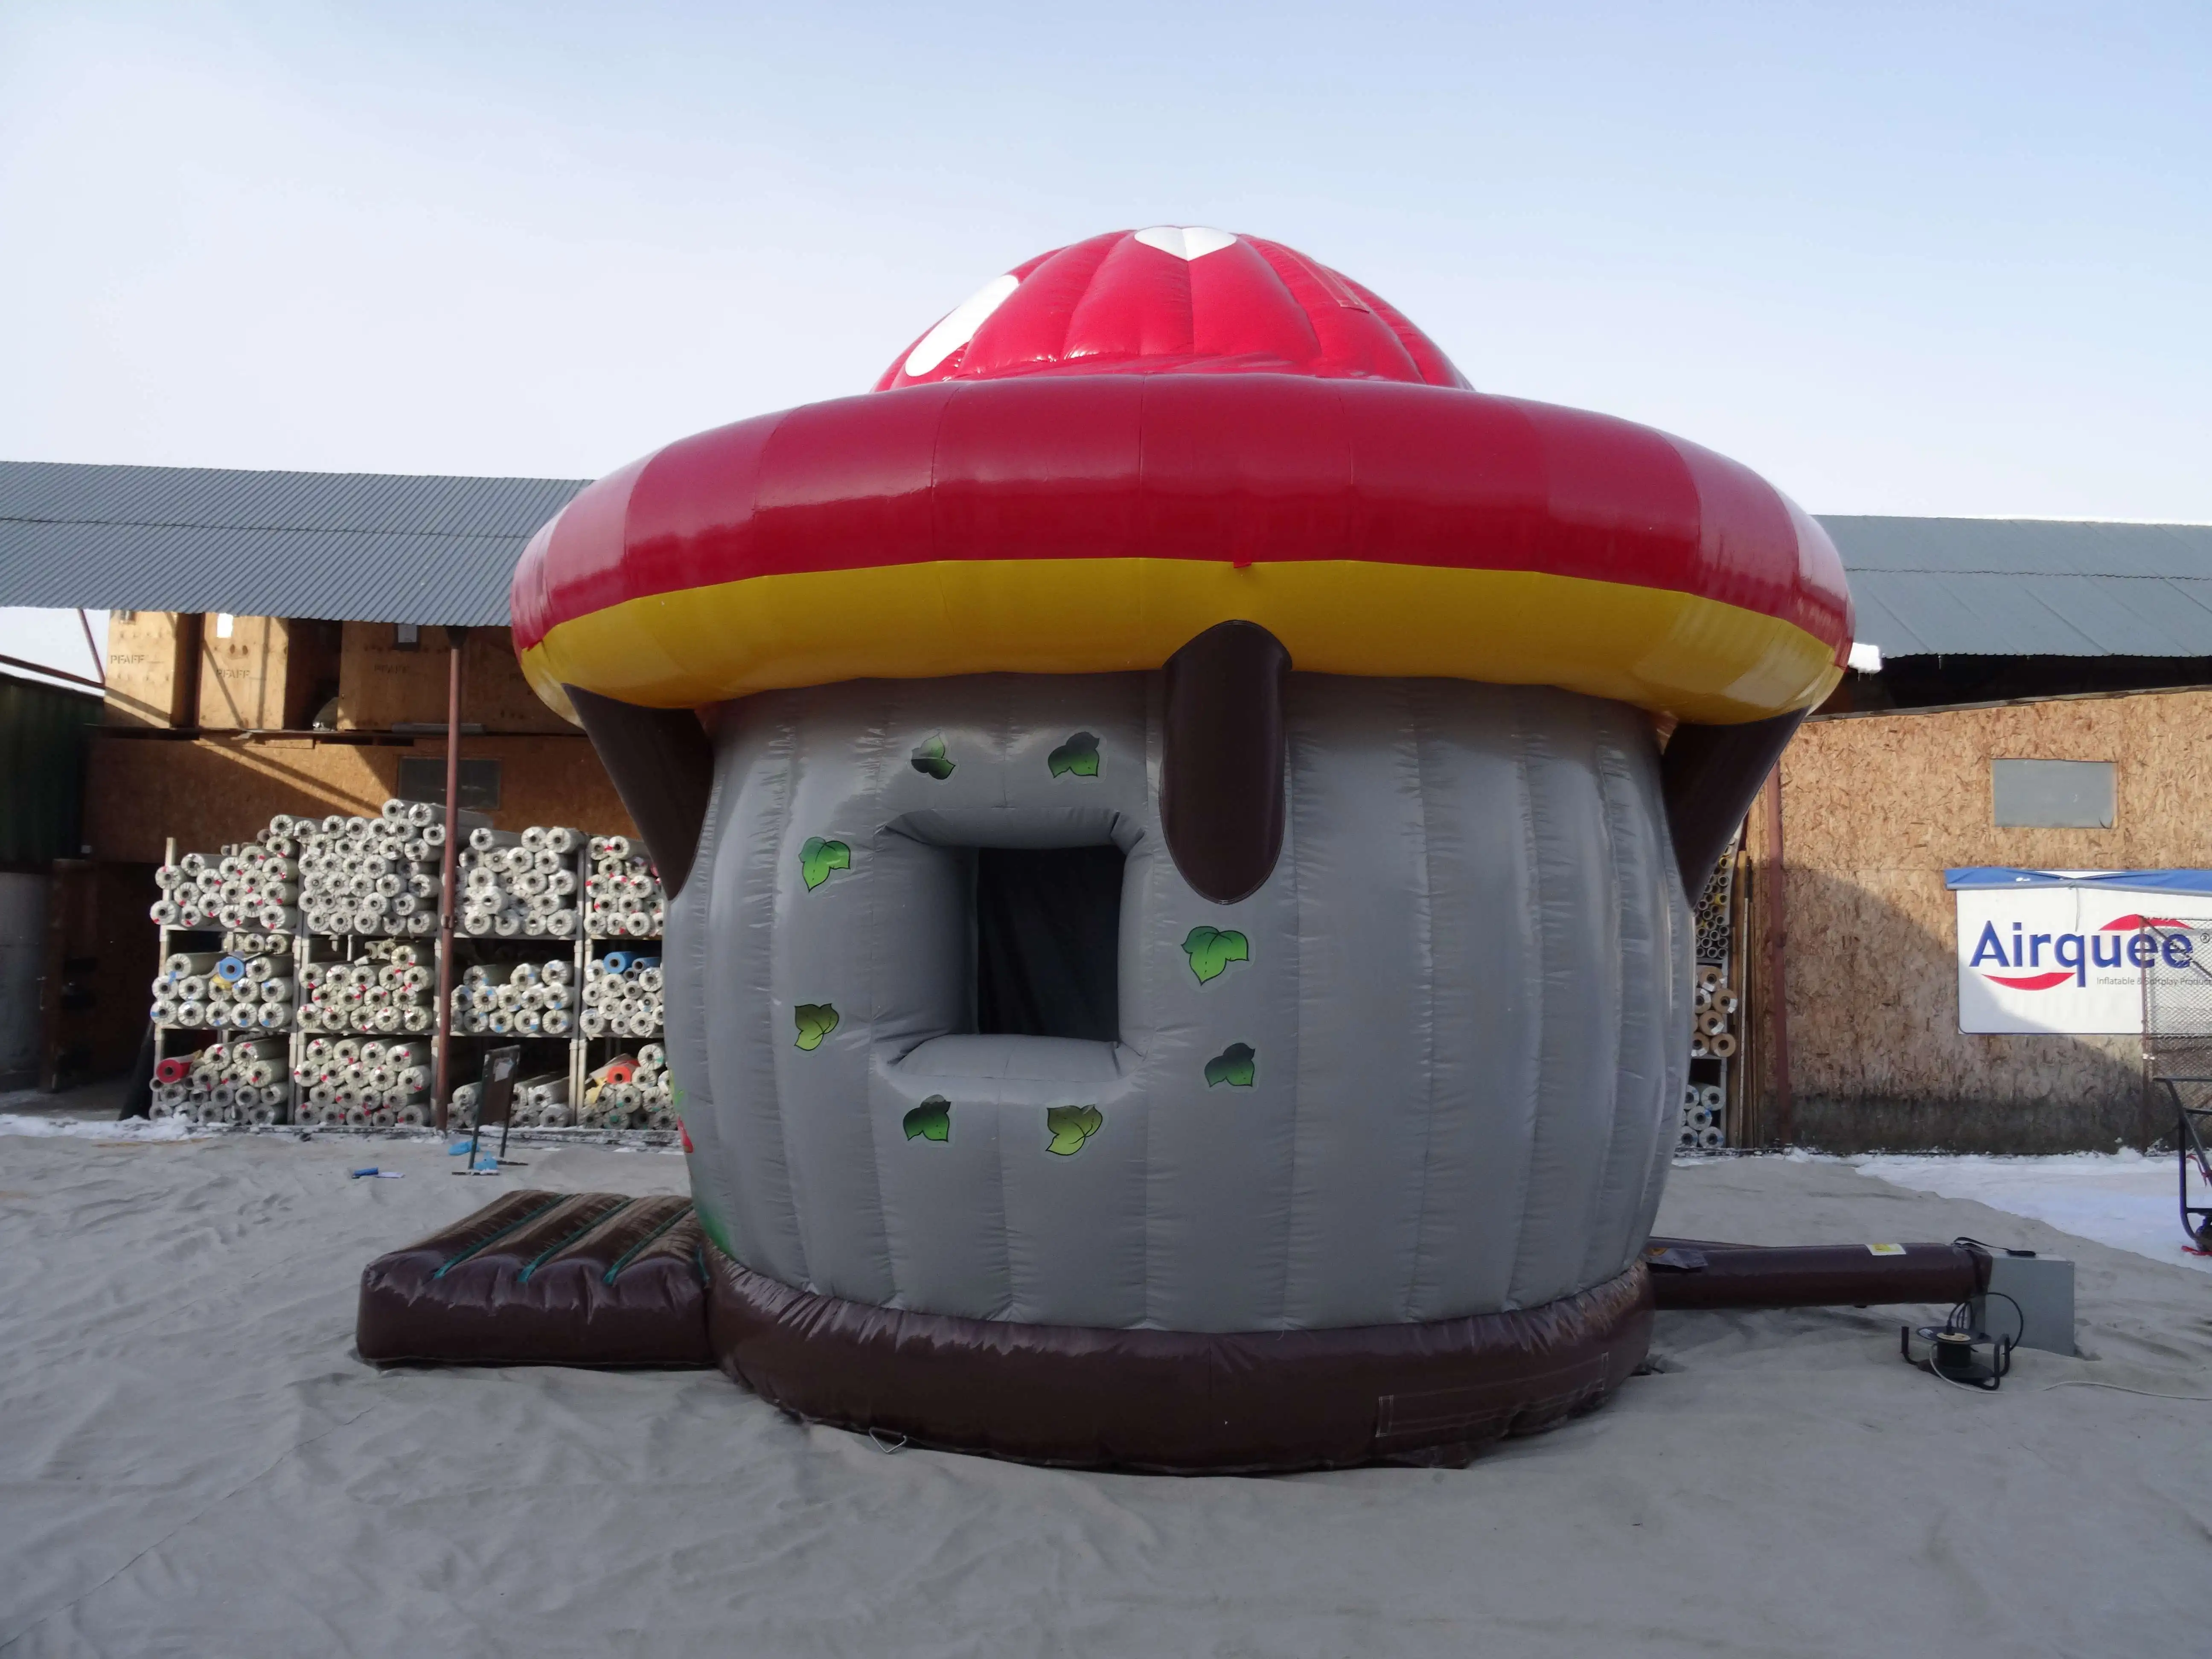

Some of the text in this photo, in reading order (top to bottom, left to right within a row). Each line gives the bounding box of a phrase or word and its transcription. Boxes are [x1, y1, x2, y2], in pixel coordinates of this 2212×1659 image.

[111, 655, 145, 664] PFAFF
[217, 669, 250, 679] PFAFF
[1969, 920, 2193, 987] Airquee
[2097, 977, 2134, 985] Inflatable
